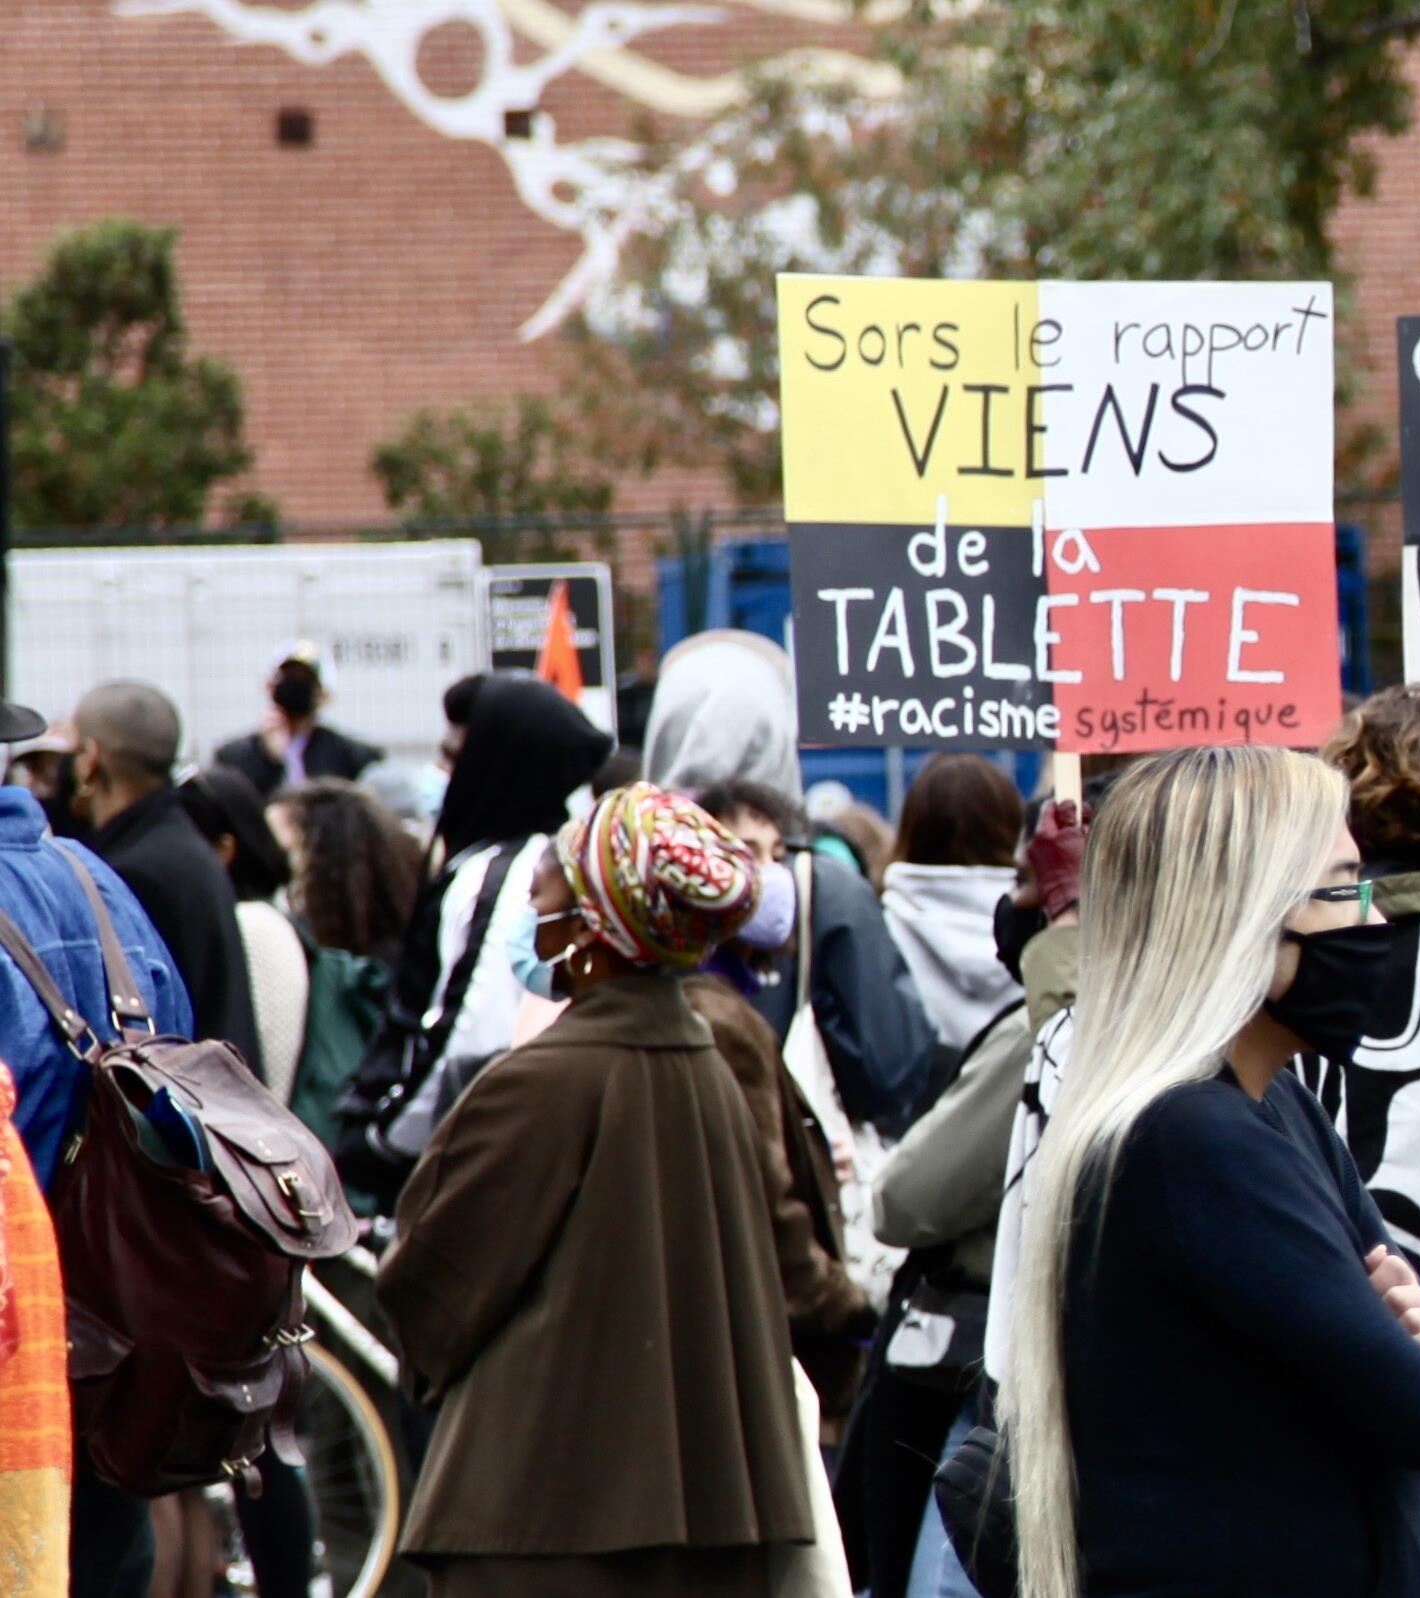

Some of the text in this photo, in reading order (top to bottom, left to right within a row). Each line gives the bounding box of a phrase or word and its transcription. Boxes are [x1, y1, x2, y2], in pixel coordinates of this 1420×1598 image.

[804, 294, 1328, 387] Sors le rapport
[890, 382, 1227, 479] VIENS
[906, 493, 1101, 578] de la
[817, 586, 1300, 684] TABLETTE
[827, 686, 1301, 748] #racisme systémique
